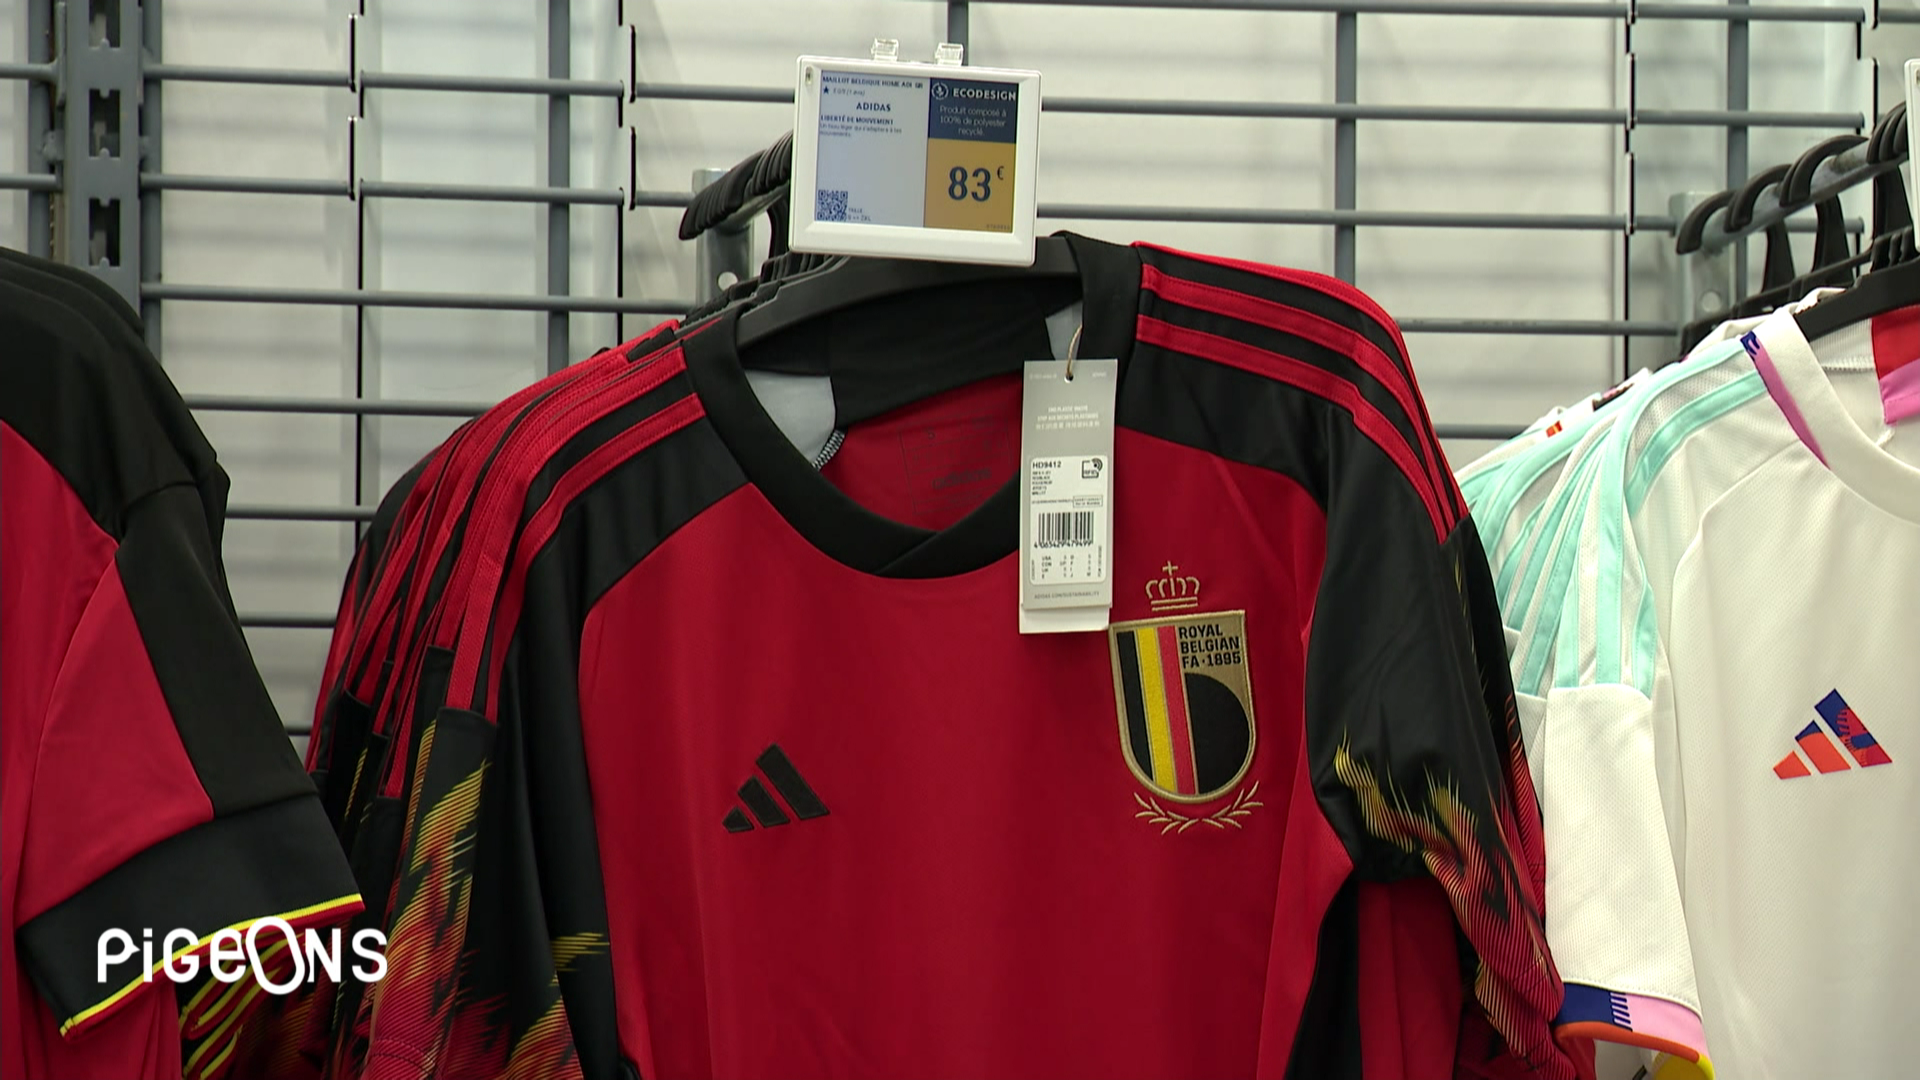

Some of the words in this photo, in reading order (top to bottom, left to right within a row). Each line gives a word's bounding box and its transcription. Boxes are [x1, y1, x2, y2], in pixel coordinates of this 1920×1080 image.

[851, 78, 881, 87] BELGIQUE
[882, 80, 900, 88] HOME
[953, 87, 1017, 101] ECODESIGN
[856, 102, 892, 112] ADIDAS
[940, 105, 967, 114] Produit
[967, 107, 1000, 117] composé
[1001, 109, 1007, 117] à
[856, 117, 894, 125] MOUVEMENT
[940, 115, 961, 125] 100%
[962, 116, 973, 125] de
[973, 118, 1006, 128] polyester
[948, 166, 991, 202] 83
[1032, 460, 1062, 469] HD9412
[1178, 623, 1224, 640] ROYAL
[1180, 636, 1240, 654] BELGIAN
